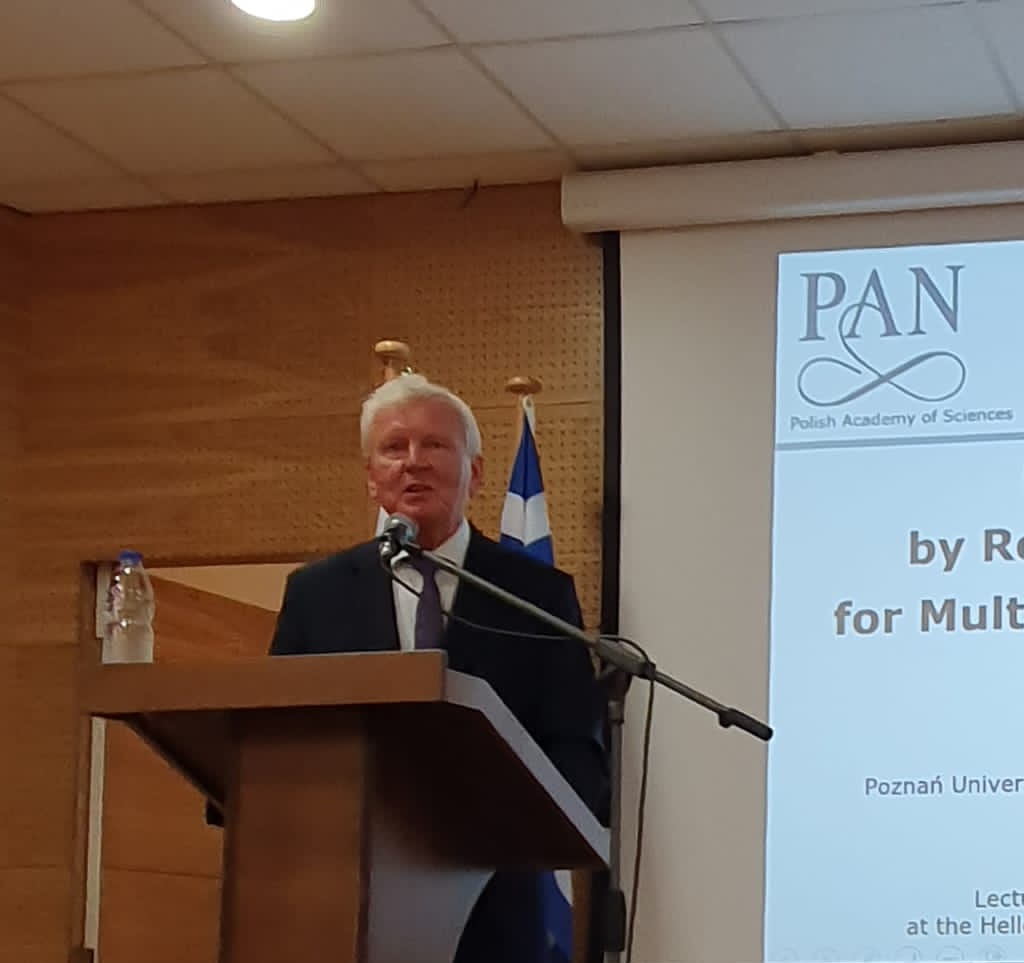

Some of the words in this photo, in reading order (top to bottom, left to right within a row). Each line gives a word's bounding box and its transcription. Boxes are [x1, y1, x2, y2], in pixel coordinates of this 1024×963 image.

[799, 265, 964, 342] PAN
[790, 415, 836, 432] Polish
[842, 413, 916, 427] Academy
[921, 408, 938, 424] of
[943, 409, 1013, 423] Sciences
[910, 531, 965, 572] by
[834, 601, 902, 635] for
[866, 776, 942, 795] Poznań
[907, 919, 928, 935] at
[936, 917, 972, 935] the
